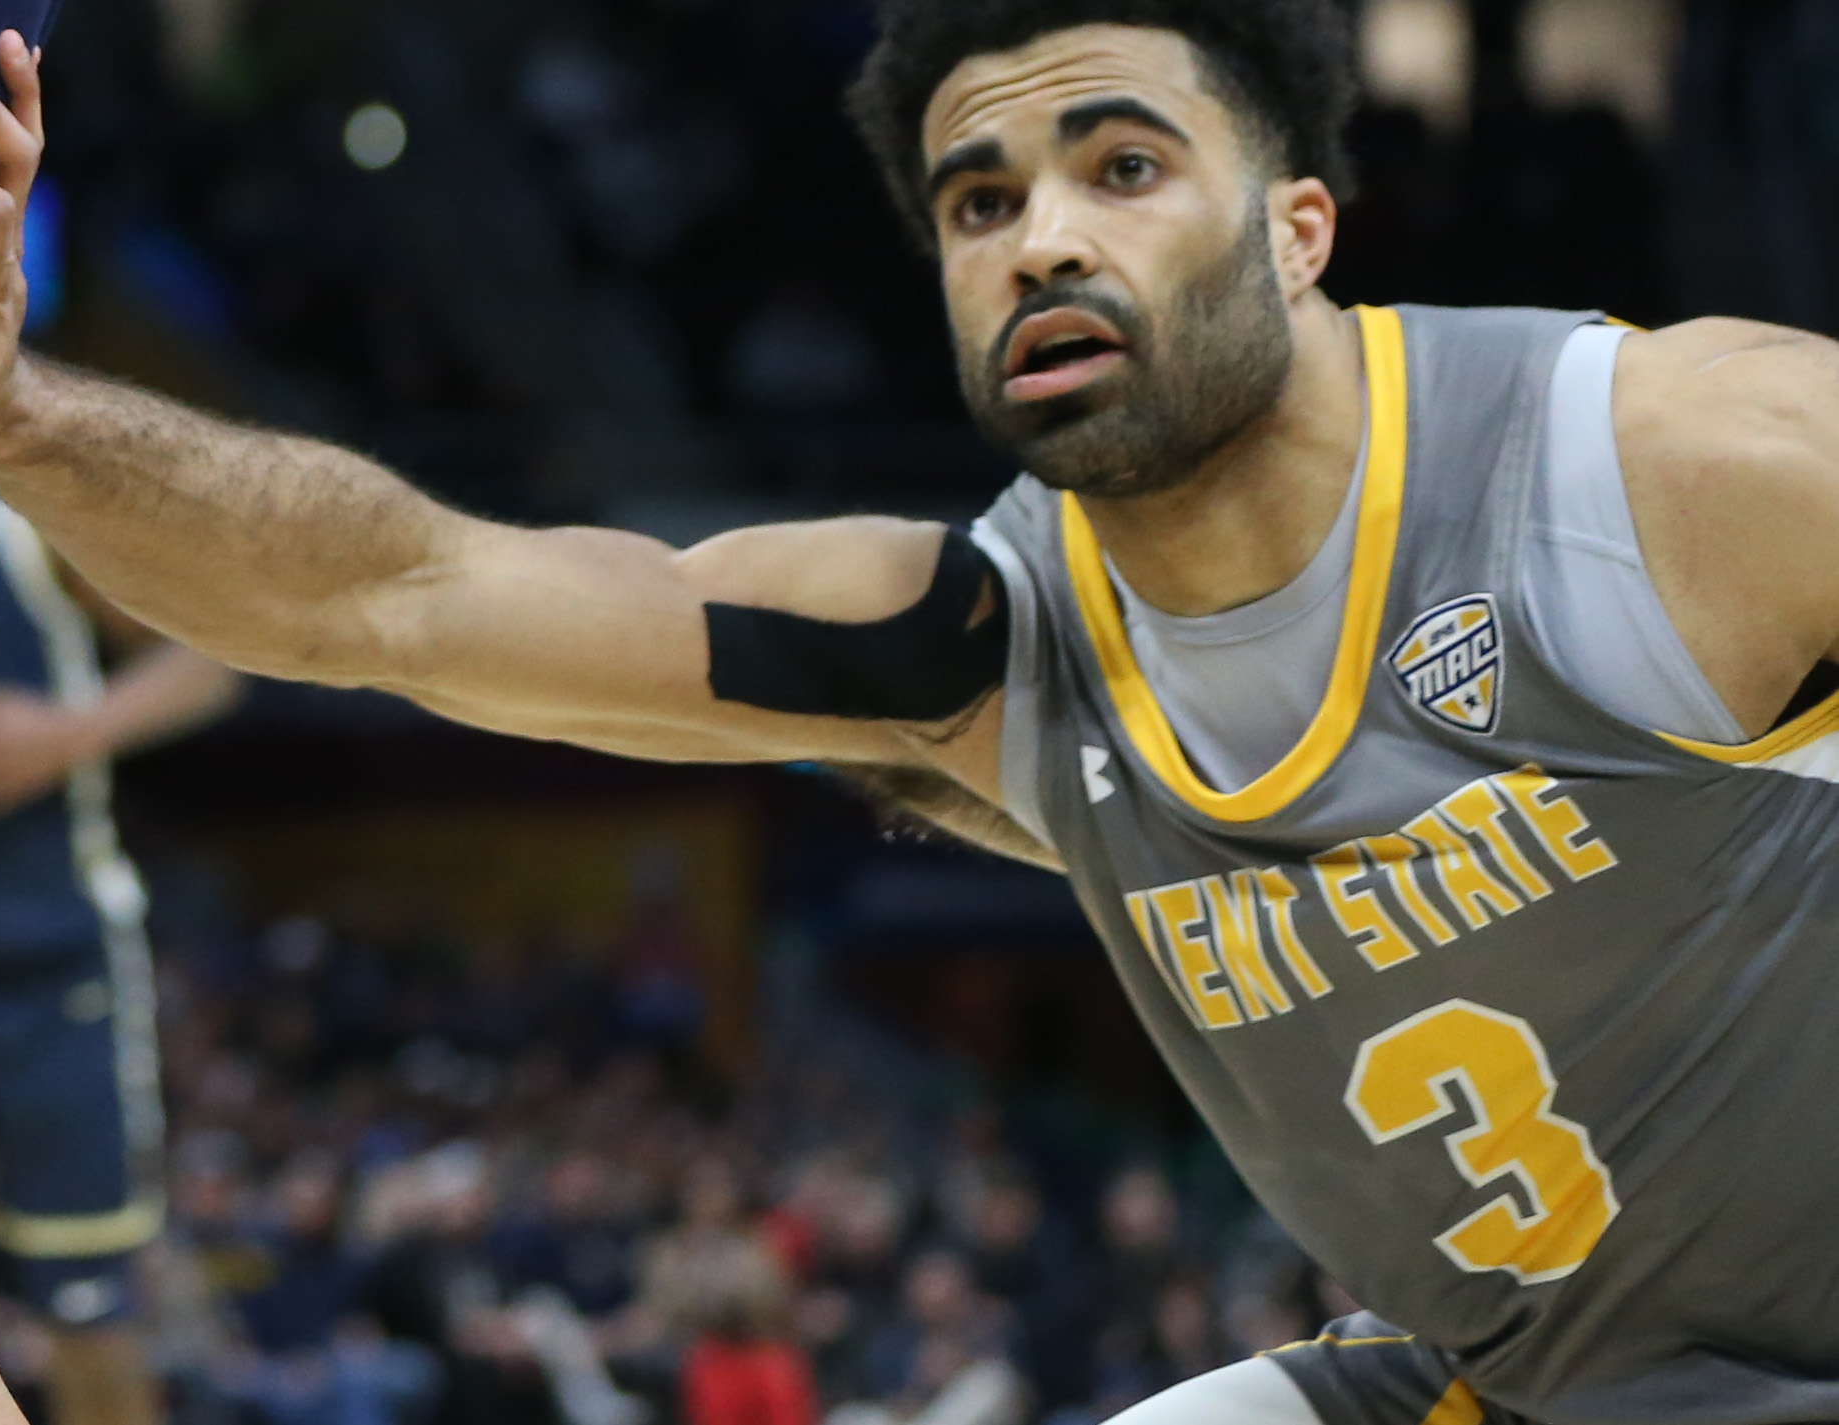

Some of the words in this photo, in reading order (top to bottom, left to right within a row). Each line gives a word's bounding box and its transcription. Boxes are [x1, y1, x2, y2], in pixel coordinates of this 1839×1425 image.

[1405, 630, 1501, 706] MAC
[1309, 761, 1619, 972] STATE
[1344, 997, 1621, 1287] 3
